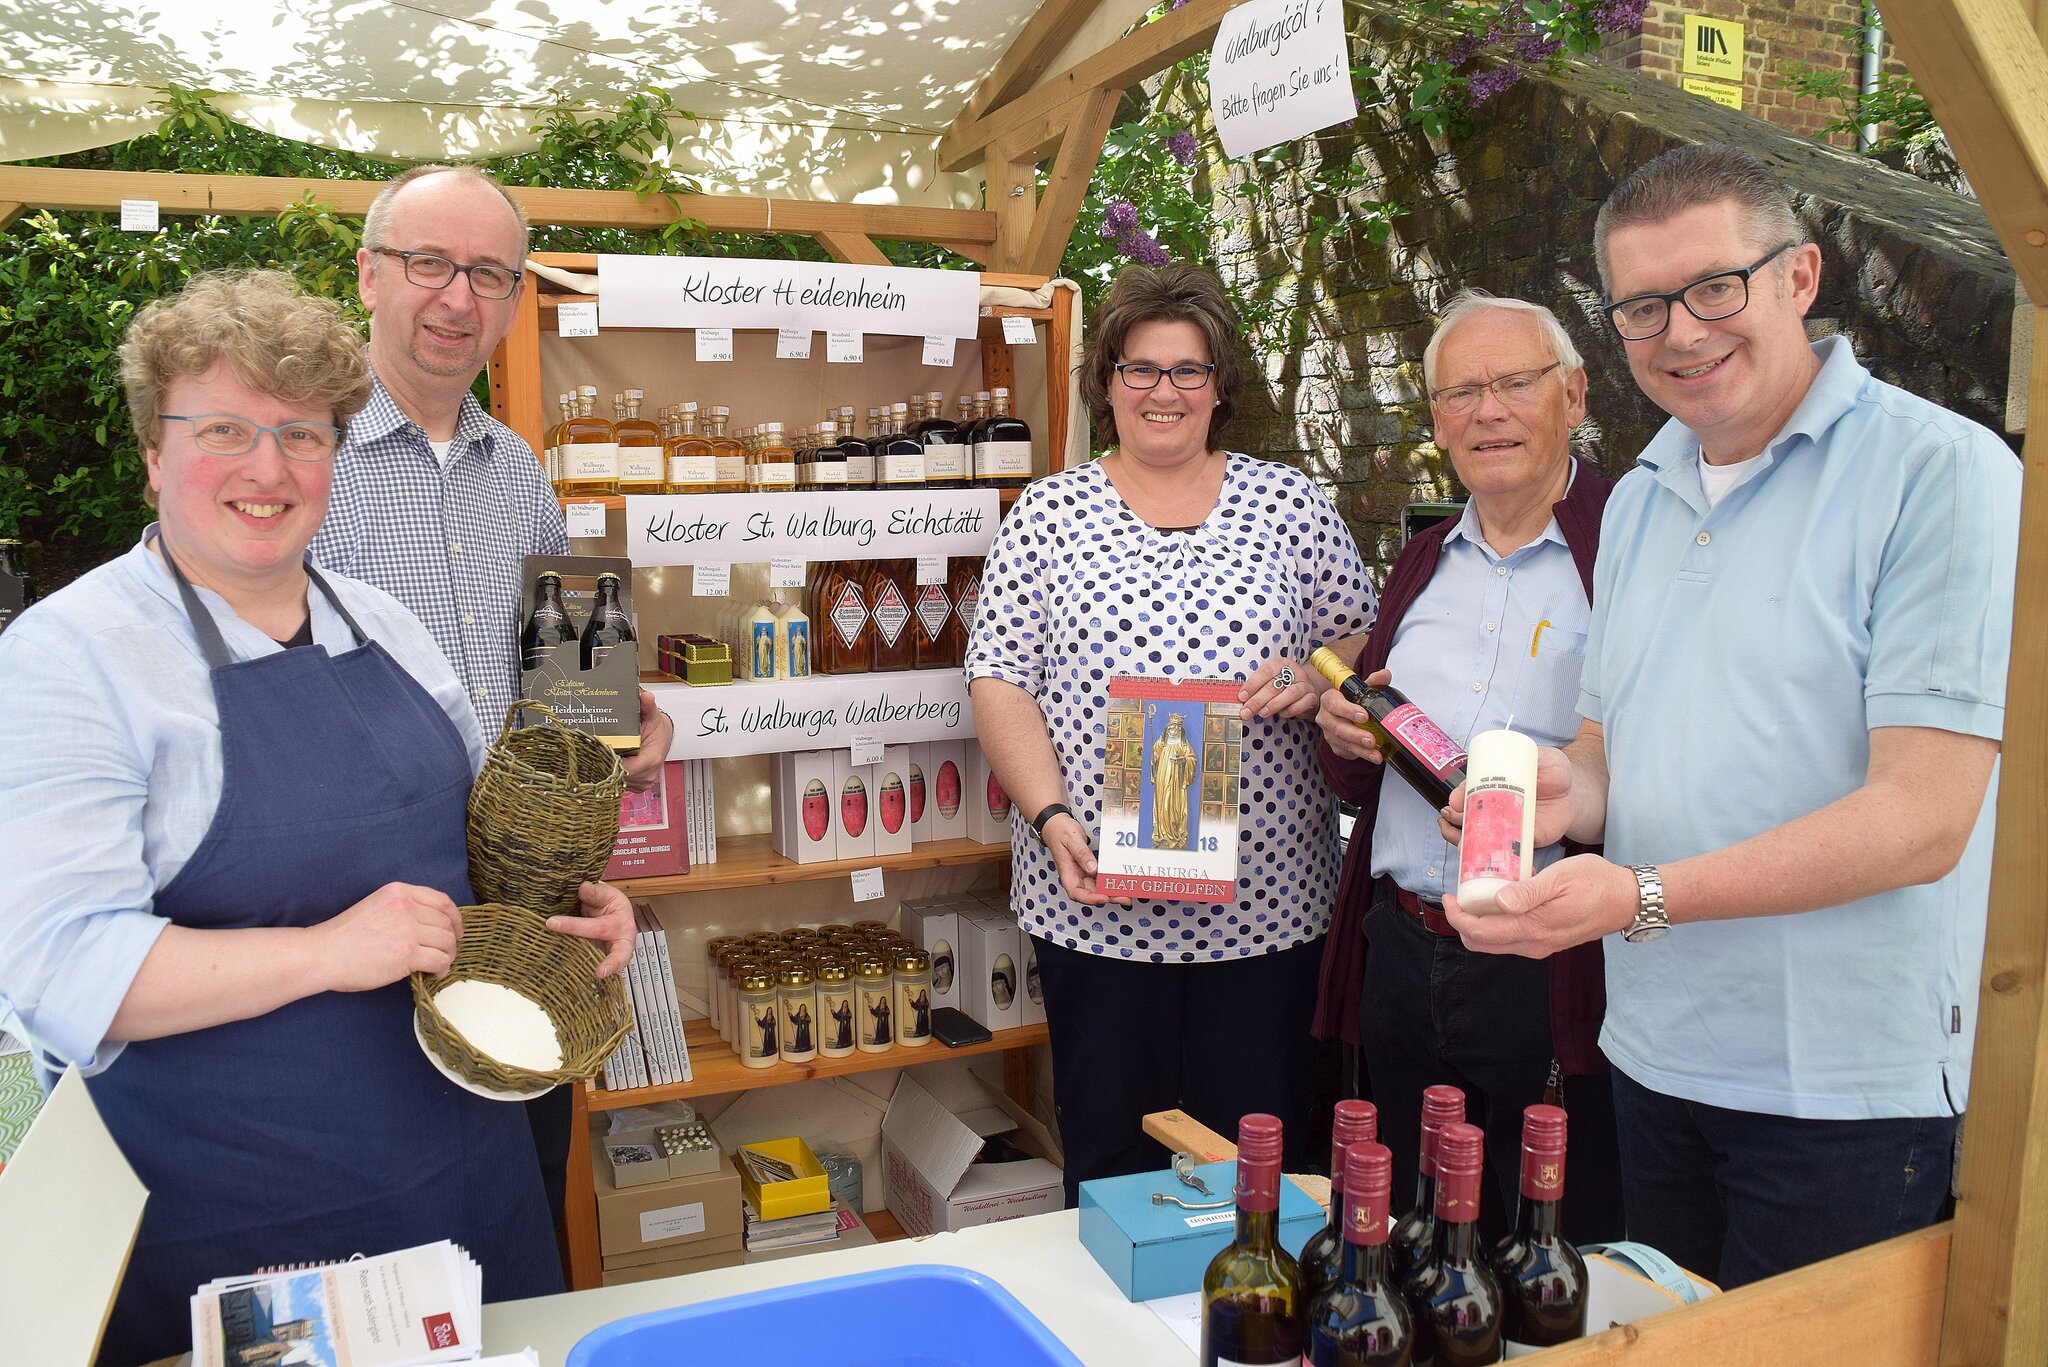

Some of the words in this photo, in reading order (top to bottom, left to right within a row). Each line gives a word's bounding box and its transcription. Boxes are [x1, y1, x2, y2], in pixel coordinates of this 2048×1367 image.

[1223, 92, 1250, 120] Bitte
[1252, 82, 1286, 116] fragen
[1290, 66, 1310, 97] Sie
[683, 271, 767, 305] Kloster
[773, 277, 906, 311] Heidenheim
[569, 328, 587, 336] 17.50
[844, 354, 858, 362] 6.90
[646, 509, 730, 543] Kloster
[888, 503, 984, 535] Eichstätt
[544, 688, 572, 696] Kloster
[574, 687, 619, 696] Heidenheim
[550, 704, 613, 714] Heidenheimer
[697, 706, 729, 736] St.
[741, 698, 837, 736] Walburga,
[846, 691, 961, 728] Walberberg
[1115, 832, 1137, 848] 20
[1200, 836, 1219, 852] 18
[1122, 864, 1210, 880] WALBURGA
[1105, 878, 1138, 891] HAT
[1141, 880, 1227, 896] GEHOLFEN
[963, 1201, 999, 1212] Weinkellerei
[1007, 1193, 1048, 1204] Weinhandlung
[359, 1270, 369, 1288] Reise
[363, 1289, 373, 1304] nach
[365, 1306, 380, 1344] Südengland
